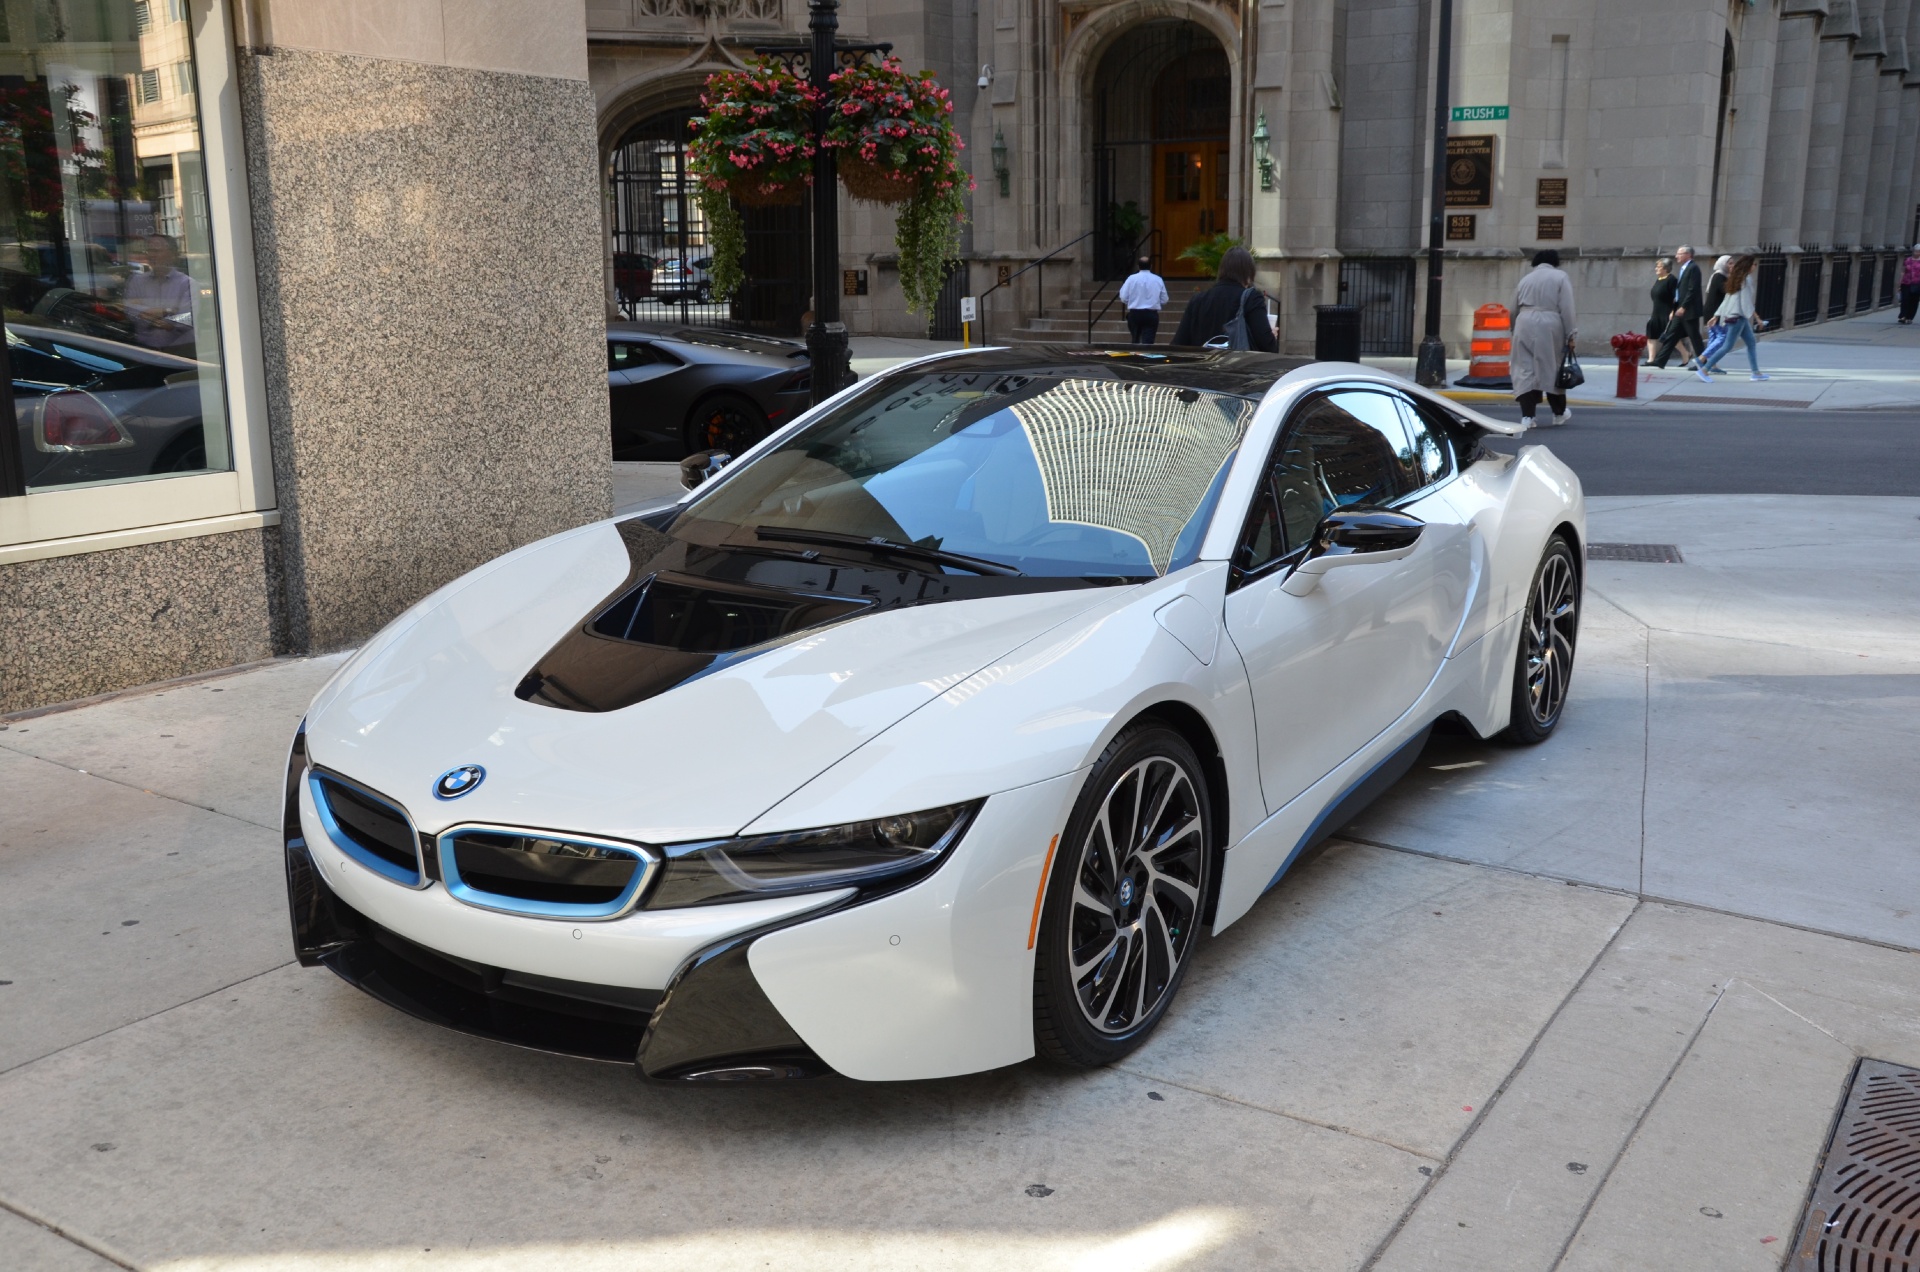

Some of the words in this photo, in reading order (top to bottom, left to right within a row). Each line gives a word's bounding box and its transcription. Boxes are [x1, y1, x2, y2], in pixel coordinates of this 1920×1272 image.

[1455, 110, 1460, 118] N
[1463, 107, 1495, 119] RUSH
[1498, 109, 1506, 117] ST
[1452, 216, 1470, 227] 835
